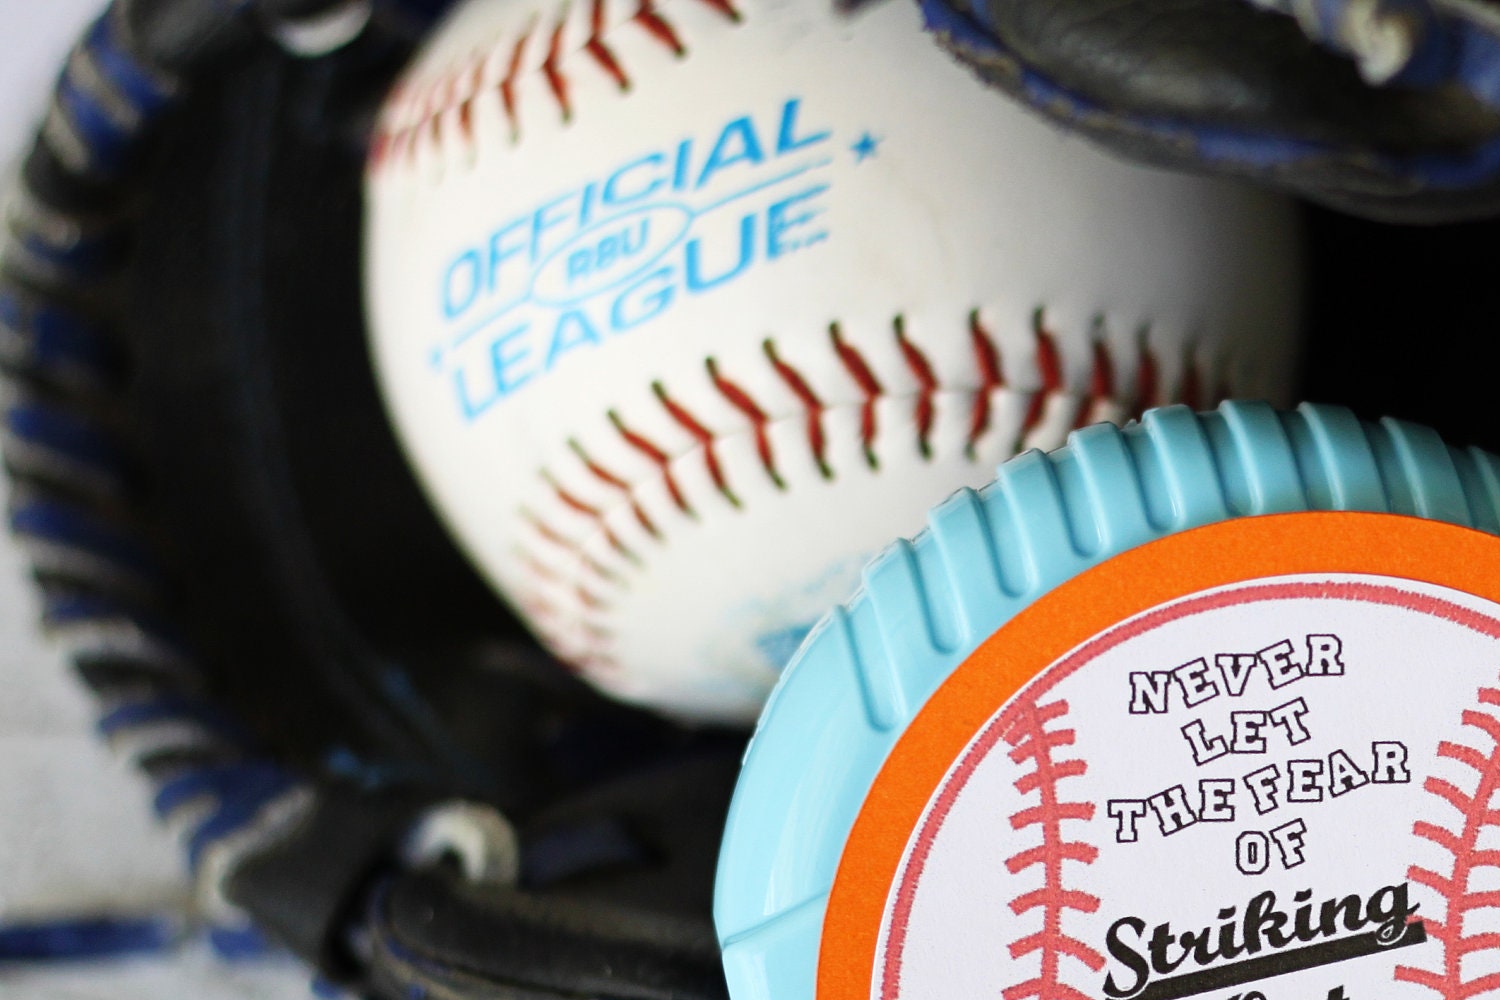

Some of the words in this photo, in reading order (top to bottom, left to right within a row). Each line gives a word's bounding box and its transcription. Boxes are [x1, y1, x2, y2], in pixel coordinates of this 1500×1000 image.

[441, 96, 833, 320] OFFICIAL
[453, 182, 831, 423] LEAGUE
[1129, 634, 1345, 714] NEVER
[1181, 697, 1311, 766] LET
[1107, 778, 1235, 843] THE
[1243, 741, 1411, 815] FEAR
[1235, 818, 1307, 875] OF
